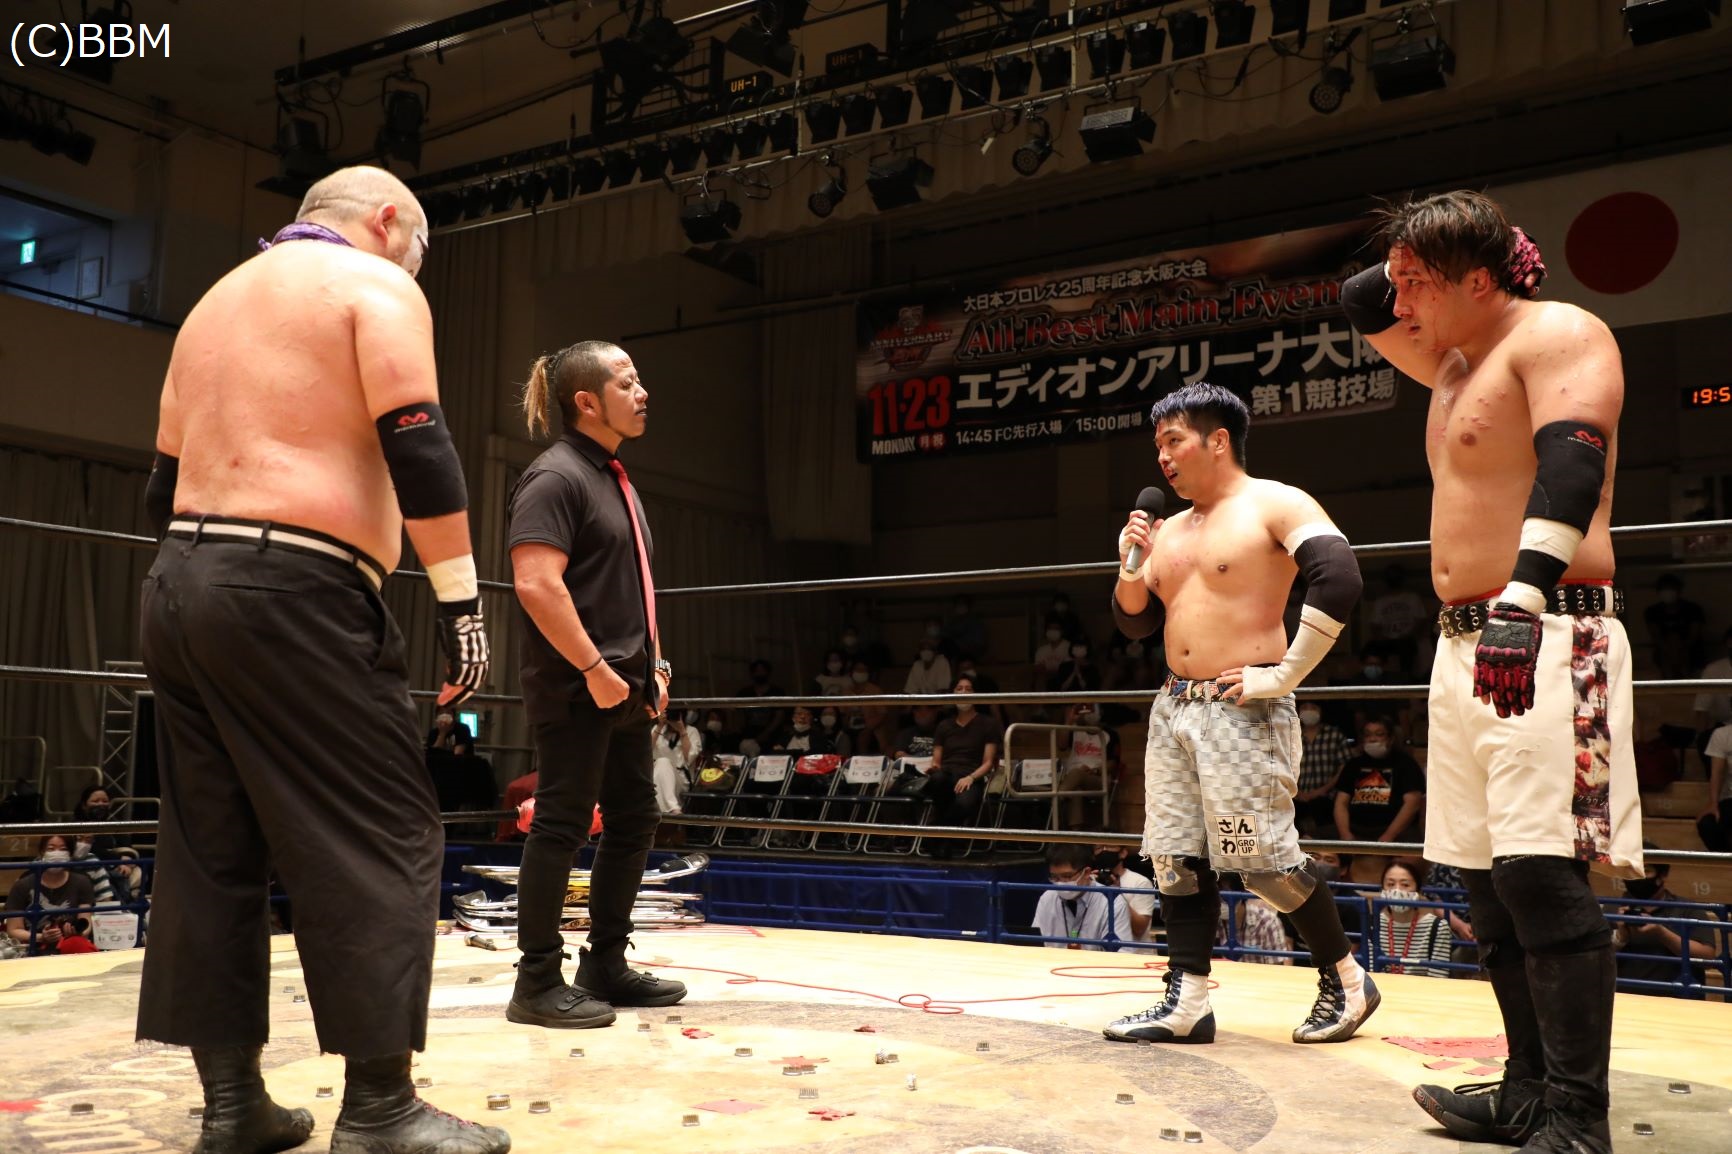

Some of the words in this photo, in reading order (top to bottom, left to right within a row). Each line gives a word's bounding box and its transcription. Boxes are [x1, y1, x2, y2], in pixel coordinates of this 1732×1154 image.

[730, 75, 758, 93] UH-1
[963, 259, 1209, 313] 大日本プロレス25周年記念大阪大会
[957, 318, 1016, 361] All
[1021, 305, 1111, 353] Best
[1114, 287, 1222, 339] Main
[1227, 272, 1348, 321] Even
[1251, 369, 1397, 417] 第1競技場
[1692, 386, 1731, 405] 19:5
[872, 436, 916, 455] MONDAY
[955, 428, 992, 446] 14:45
[10, 838, 29, 852] 21
[1691, 881, 1711, 896] 19
